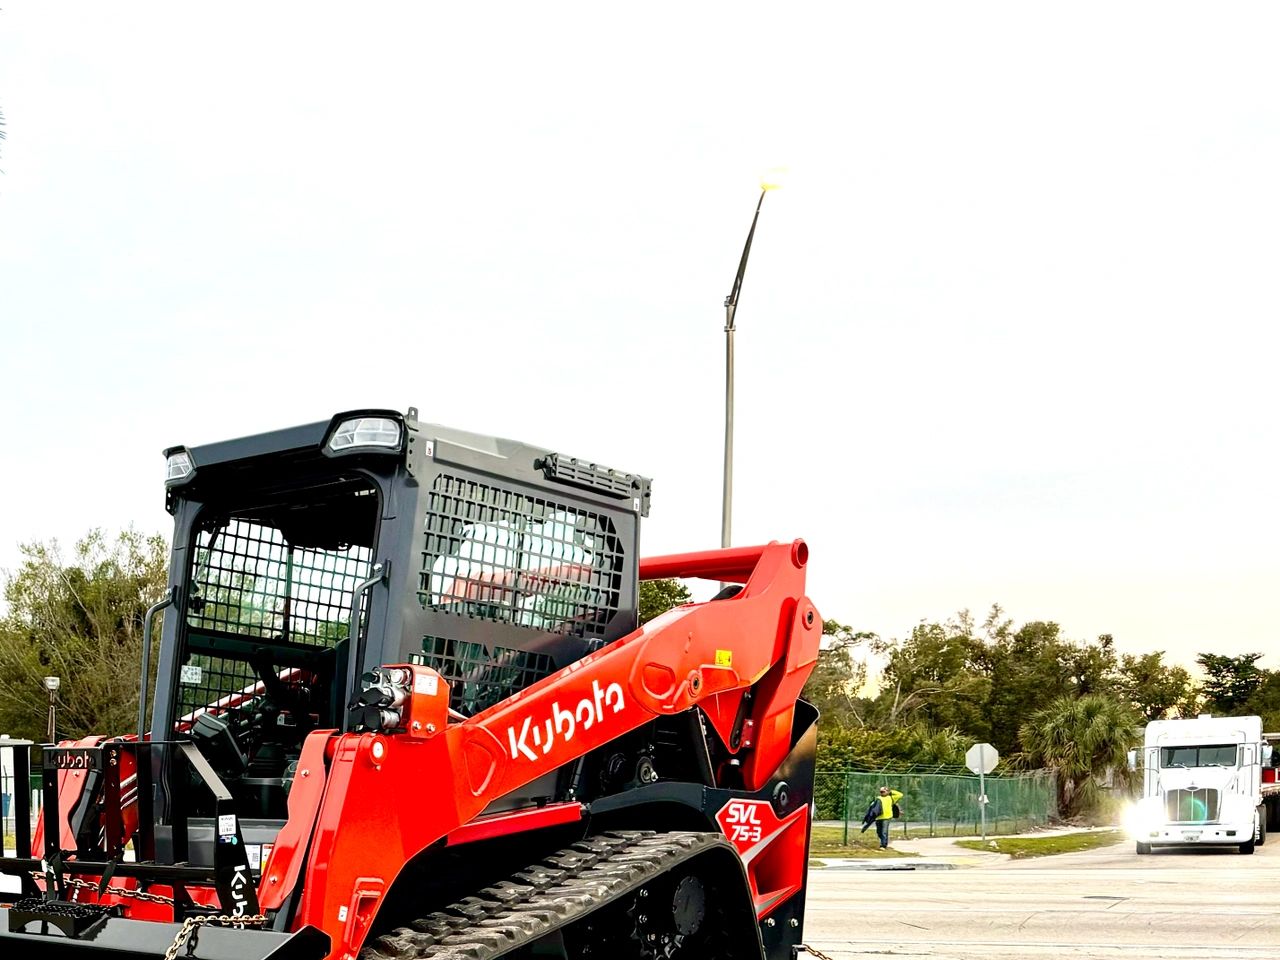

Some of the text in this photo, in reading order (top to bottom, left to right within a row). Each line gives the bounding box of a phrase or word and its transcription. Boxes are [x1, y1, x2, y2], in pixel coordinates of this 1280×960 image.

[507, 679, 626, 762] Kubota
[48, 750, 97, 768] ubot
[725, 803, 762, 825] SVL
[730, 825, 762, 842] 75-3
